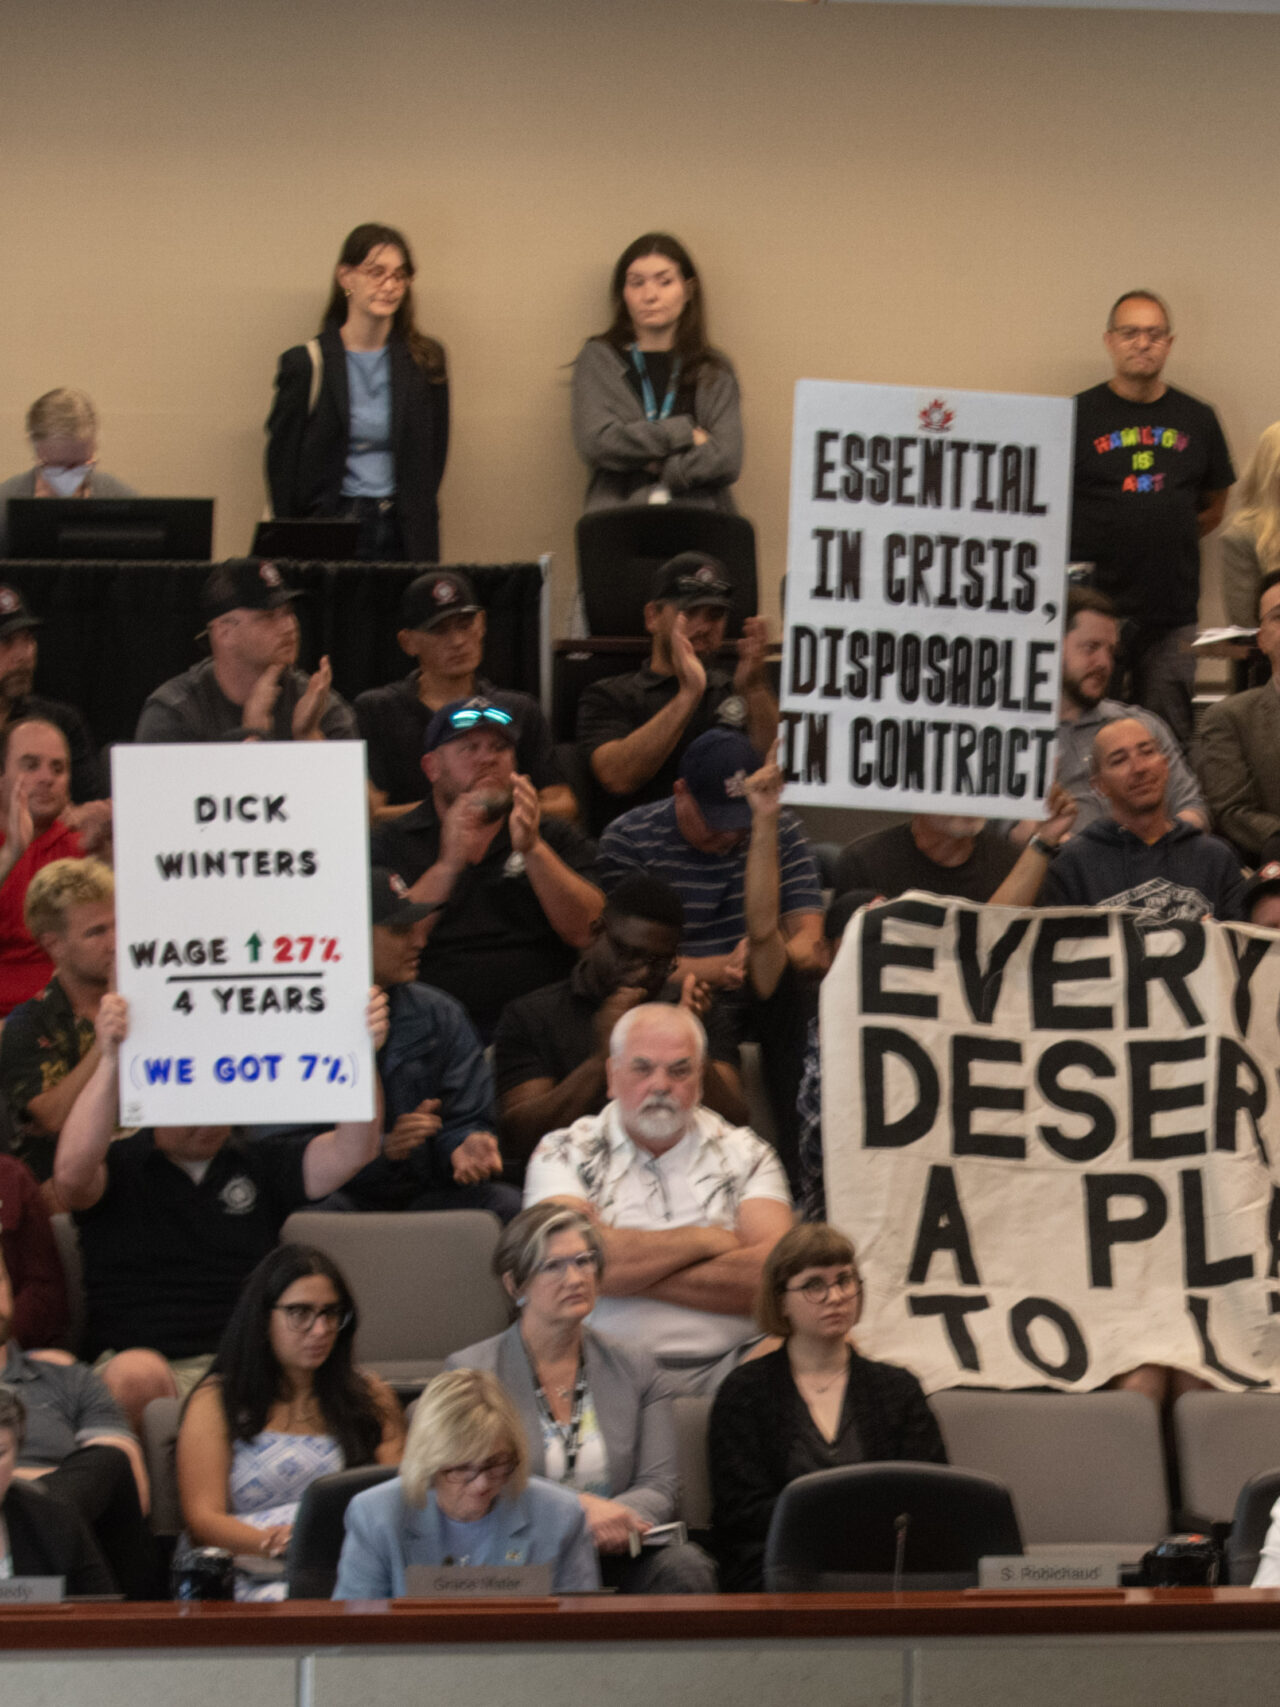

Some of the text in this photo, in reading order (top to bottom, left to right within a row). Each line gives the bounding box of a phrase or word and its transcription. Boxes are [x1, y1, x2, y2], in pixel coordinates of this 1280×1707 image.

[1093, 426, 1189, 454] HAMILTON
[812, 429, 1048, 516] ESSENTIAL
[1132, 451, 1154, 470] IS
[1122, 473, 1165, 492] ART
[810, 528, 1058, 624] IN CRISIS,
[788, 624, 1057, 713] DISPOSABLE
[779, 711, 1056, 799] IN CONTRACT
[195, 795, 288, 823] DICK
[156, 850, 319, 880] WINTERS
[129, 936, 342, 968] WAGE 27%
[172, 986, 328, 1016] 4 YEARS
[213, 1054, 285, 1084] GOT
[908, 1165, 981, 1286] A
[907, 1294, 1089, 1384] TO
